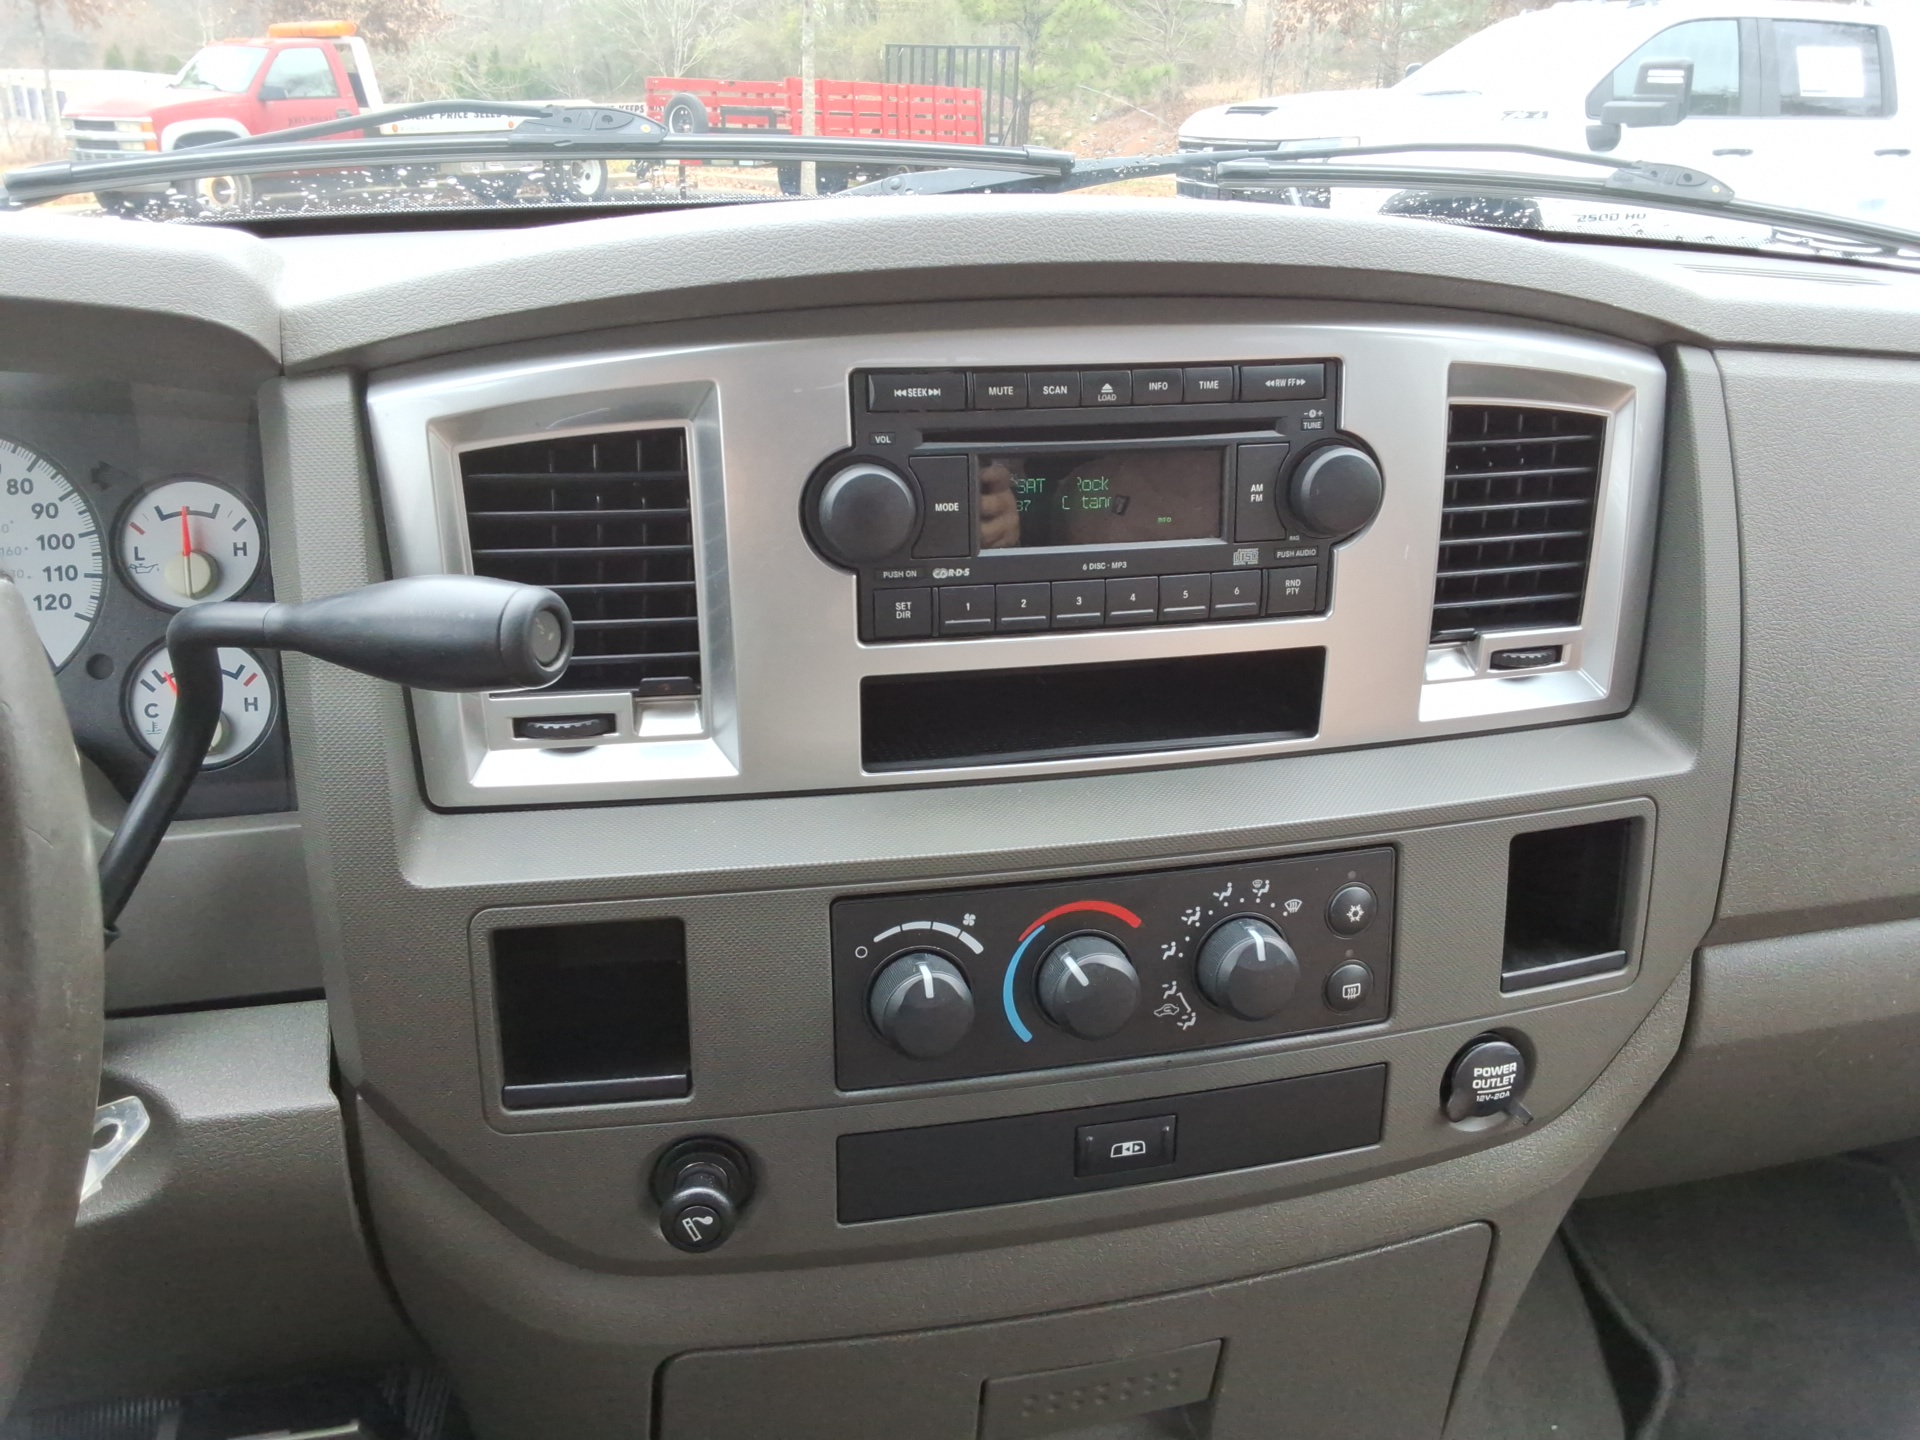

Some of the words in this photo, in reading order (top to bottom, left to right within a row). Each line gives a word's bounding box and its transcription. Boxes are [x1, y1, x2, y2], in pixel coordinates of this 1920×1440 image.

[1148, 382, 1169, 391] INFO
[1199, 380, 1219, 390] TIME
[1275, 378, 1286, 388] RW
[1288, 377, 1296, 387] FF
[907, 388, 928, 398] SEEK
[988, 386, 1014, 396] MUTE
[1043, 386, 1068, 395] SCAN
[1097, 393, 1117, 402] LOAD
[1302, 421, 1322, 429] TUNE
[874, 436, 892, 444] VOL
[6, 477, 34, 496] 80
[1017, 478, 1046, 494] SAT
[1250, 483, 1264, 493] AM
[1250, 494, 1264, 503] FM
[31, 502, 60, 520] 90
[934, 502, 960, 512] MODE
[35, 533, 76, 552] 100
[134, 547, 145, 562] L
[232, 542, 248, 557] H
[1276, 551, 1295, 559] PUSH
[1296, 549, 1317, 557] AUDIO
[1082, 564, 1088, 572] 6
[1089, 562, 1107, 571] DISC
[1111, 561, 1128, 570] MP3
[42, 564, 79, 582] 110
[883, 570, 903, 579] PUSH
[905, 570, 918, 578] ON
[1285, 579, 1302, 588] RND
[1183, 590, 1189, 599] 5
[1234, 586, 1240, 595] 6
[1285, 587, 1300, 596] PTY
[33, 593, 72, 611] 120
[1076, 597, 1083, 605] 3
[1130, 593, 1137, 602] 4
[895, 602, 912, 611] SET
[965, 603, 971, 611] 1
[1020, 599, 1027, 608] 2
[896, 610, 912, 619] DIR
[243, 697, 259, 712] H
[144, 703, 160, 718] C
[1474, 1062, 1517, 1077] POWER
[1472, 1074, 1516, 1089] OUTLET
